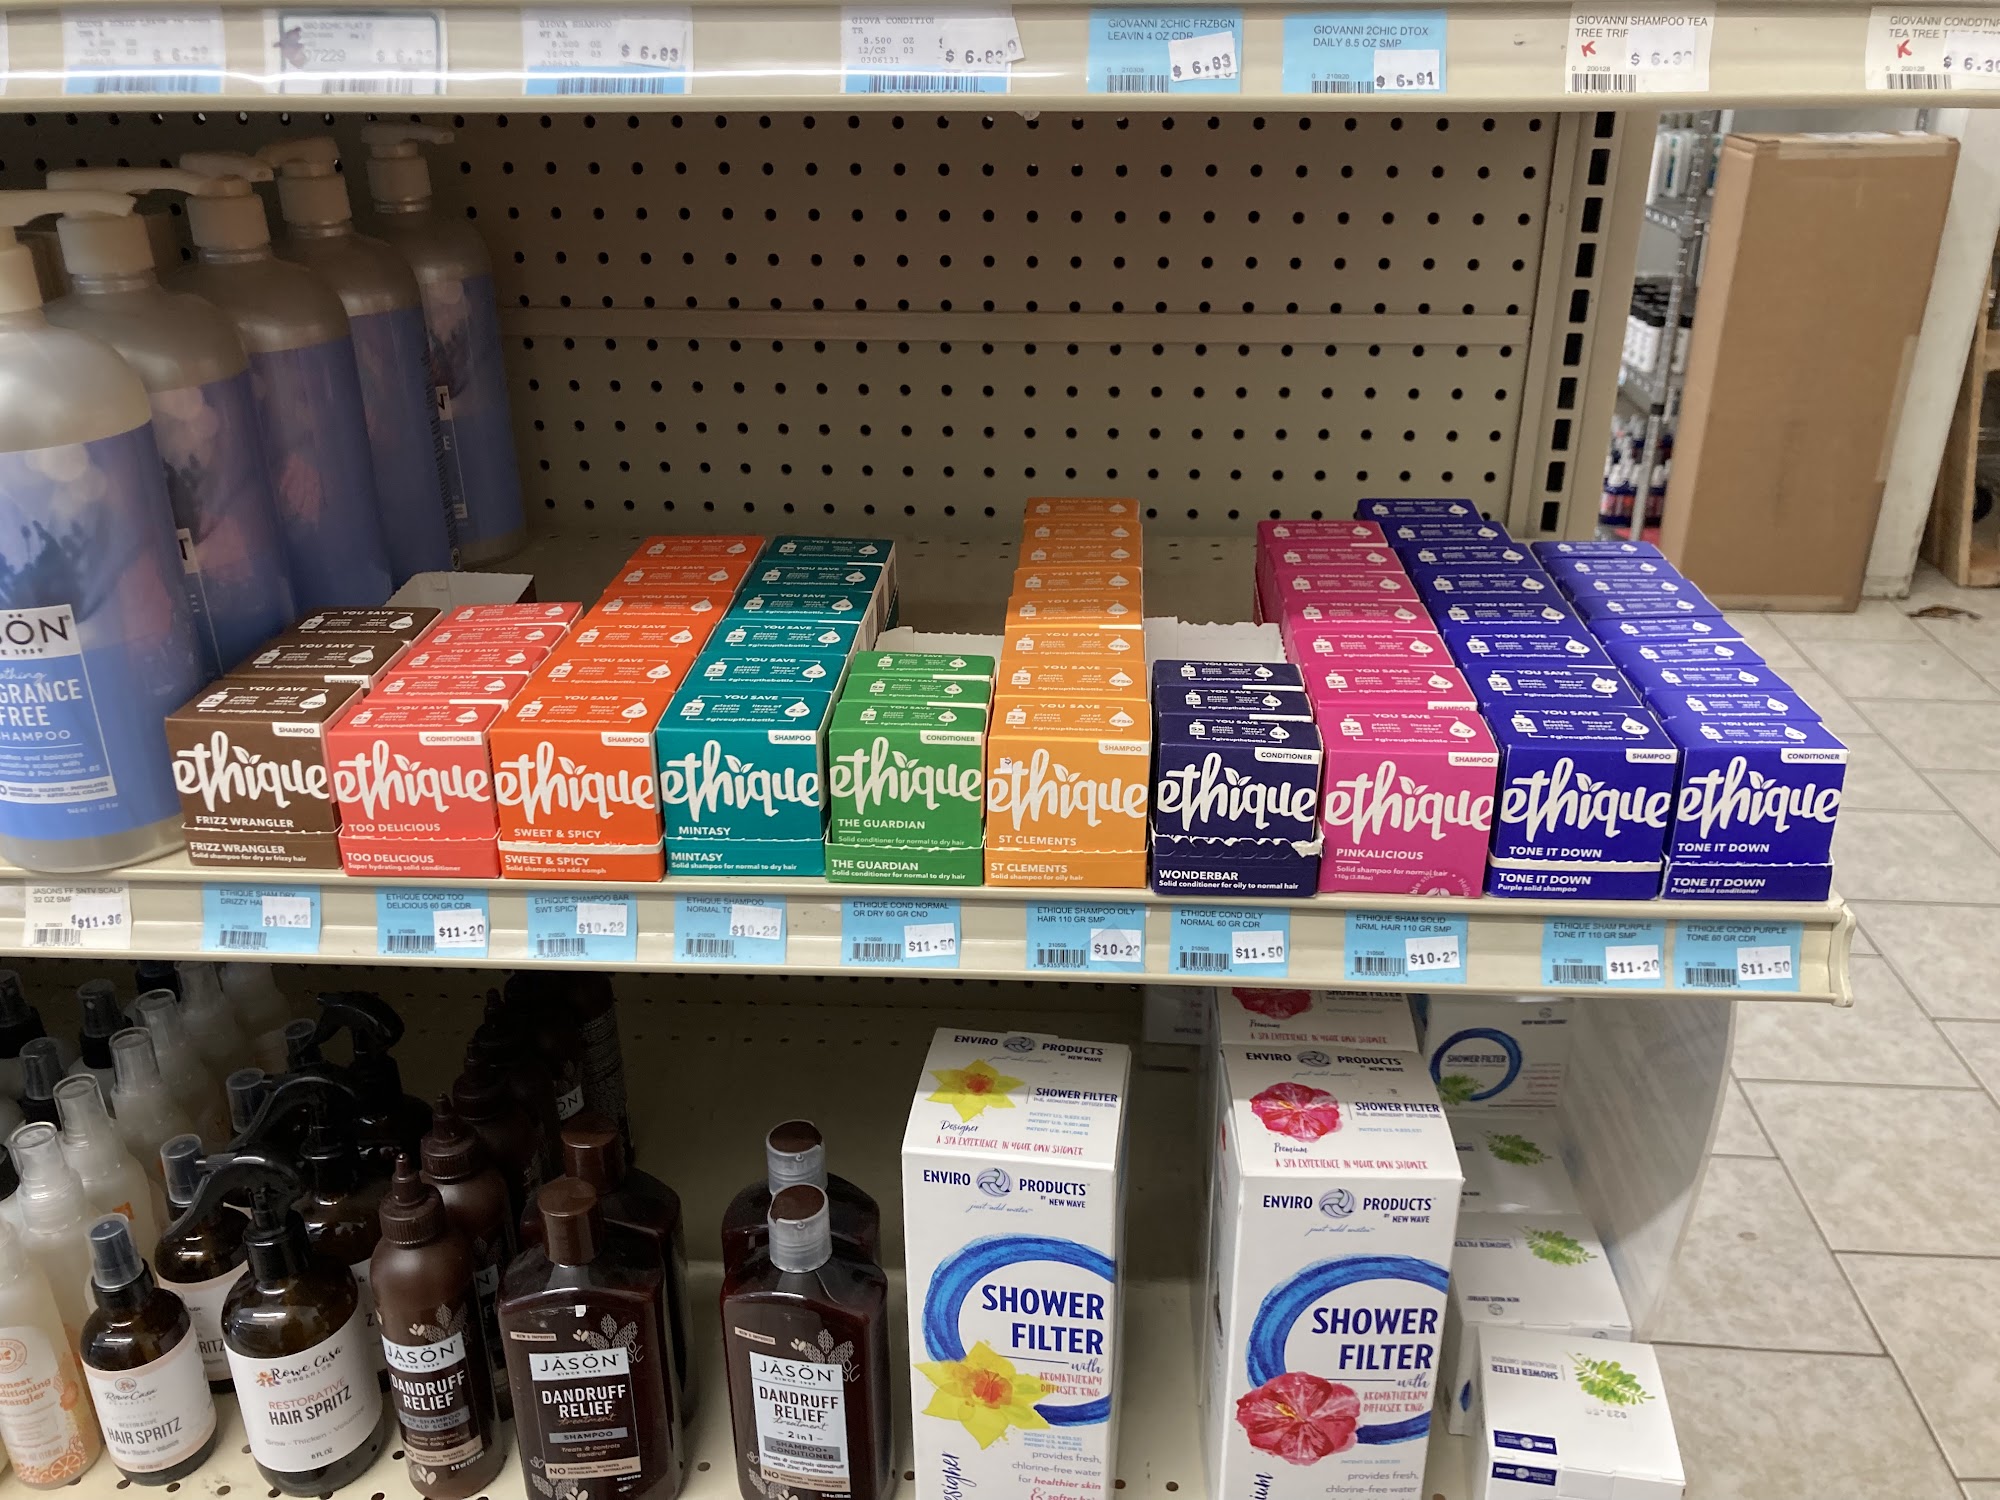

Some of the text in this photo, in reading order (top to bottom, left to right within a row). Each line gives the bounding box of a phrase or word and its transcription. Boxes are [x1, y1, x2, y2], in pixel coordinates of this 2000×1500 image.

[1108, 19, 1235, 29] GIOVANNI 2CHIC FRZBGN
[1576, 15, 1708, 26] GIOVANNI SHAMPOO TEA
[1107, 31, 1144, 41] LEAVIN
[1146, 32, 1152, 41] 4
[1155, 32, 1169, 41] OZ
[1313, 25, 1429, 36] GIOVANNI 2CHIC DTOX
[1575, 28, 1603, 37] TREE
[1888, 28, 1940, 38] TEA TREE
[863, 37, 914, 45] 8.500 OZ
[1313, 37, 1402, 48] DAILY 8.5 OZ SMP
[278, 727, 315, 735] SHAMPOO
[607, 736, 645, 744] SHAMPOO
[774, 734, 812, 742] SHAMPOO
[1260, 752, 1313, 760] CONDITIONER
[1455, 756, 1494, 764] SHAMPOO
[1632, 752, 1672, 760] SHAMPOO
[1787, 752, 1840, 760] CONDITIONER
[172, 731, 331, 813] ethique
[829, 737, 981, 816] ethique
[334, 740, 491, 820] ethique
[494, 741, 655, 825] ethique
[660, 740, 820, 823] ethique
[986, 748, 1148, 832] ethique
[1158, 753, 1317, 831] ethique
[1325, 761, 1495, 845] ethique
[1500, 757, 1671, 843] ethique
[1677, 756, 1841, 840] ethique
[196, 816, 294, 828] FRIZZ WRANGLER
[349, 824, 440, 832] TOO DELICIOUS
[838, 819, 925, 830] THE GUARDIAN
[514, 828, 602, 840] SWEET & SPICY
[679, 826, 731, 837] MINTASY
[999, 835, 1077, 847] ST CLEMENTS
[190, 841, 286, 854] FRIZZ WRANGLER
[1509, 846, 1602, 858] TONE IT DOWN
[1677, 843, 1770, 854] TONE IT DOWN
[346, 853, 434, 863] TOO DELICIOUS
[671, 852, 723, 863] MINTASY
[1336, 848, 1424, 861] PINKALICIOUS
[505, 855, 590, 867] SWEET & SPICY
[832, 860, 918, 871] THE GUARDIAN
[991, 863, 1067, 874] ST CLEMENTS
[1159, 870, 1238, 881] WONDERBAR
[1499, 873, 1591, 885] TONE IT DOWN
[1234, 883, 1246, 892] oily
[1672, 877, 1766, 888] TONE IT DOWN
[853, 910, 865, 918] OR
[867, 910, 884, 918] DRY
[897, 911, 910, 919] GR
[911, 911, 929, 919] CND
[1074, 907, 1116, 915] SHAMPOO
[1087, 916, 1106, 924] SMP
[1356, 923, 1452, 933] NRML HAIR 110 GR SMP
[954, 1035, 1104, 1056] ENVIRO PRODUCTS
[1246, 1052, 1401, 1066] ENVIRO PRODUCTS
[1036, 1088, 1118, 1103] SHOWER FILTER
[1355, 1101, 1440, 1113] SHOWER FILTER
[940, 1119, 979, 1136] Designer
[923, 1169, 1087, 1197] ENVIRO PRODUCTS
[1049, 1198, 1086, 1209] NEW WAVE
[1263, 1195, 1432, 1211] ENVIRO PRODUCTS
[1392, 1216, 1430, 1224] NEW WAVE
[982, 1284, 1105, 1321] SHOWER
[1311, 1307, 1439, 1335] SHOWER
[1012, 1322, 1104, 1356] FILTER
[1339, 1344, 1434, 1371] FILTER
[1071, 1360, 1103, 1374] with
[391, 1370, 465, 1396] DANDRUFF
[1398, 1373, 1430, 1389] with
[269, 1376, 346, 1411] RESTORATIVE
[542, 1384, 626, 1405] DANDRUFF
[759, 1386, 839, 1410] DANDRUFF
[269, 1385, 352, 1426] HAIR SPRITZ
[403, 1391, 454, 1411] RELIEF
[559, 1401, 614, 1419] RELIEF
[774, 1404, 826, 1423] RELIEF
[107, 1416, 183, 1445] HAIR SPRITZ
[563, 1431, 613, 1441] SHAMPOO
[771, 1445, 834, 1460] CONDITIONER
[1032, 1451, 1102, 1465] provides fresh,
[549, 1467, 566, 1475] NO
[764, 1470, 779, 1479] NO
[1012, 1461, 1102, 1477] chlorine-free water
[1018, 1474, 1102, 1490] for healthier skin
